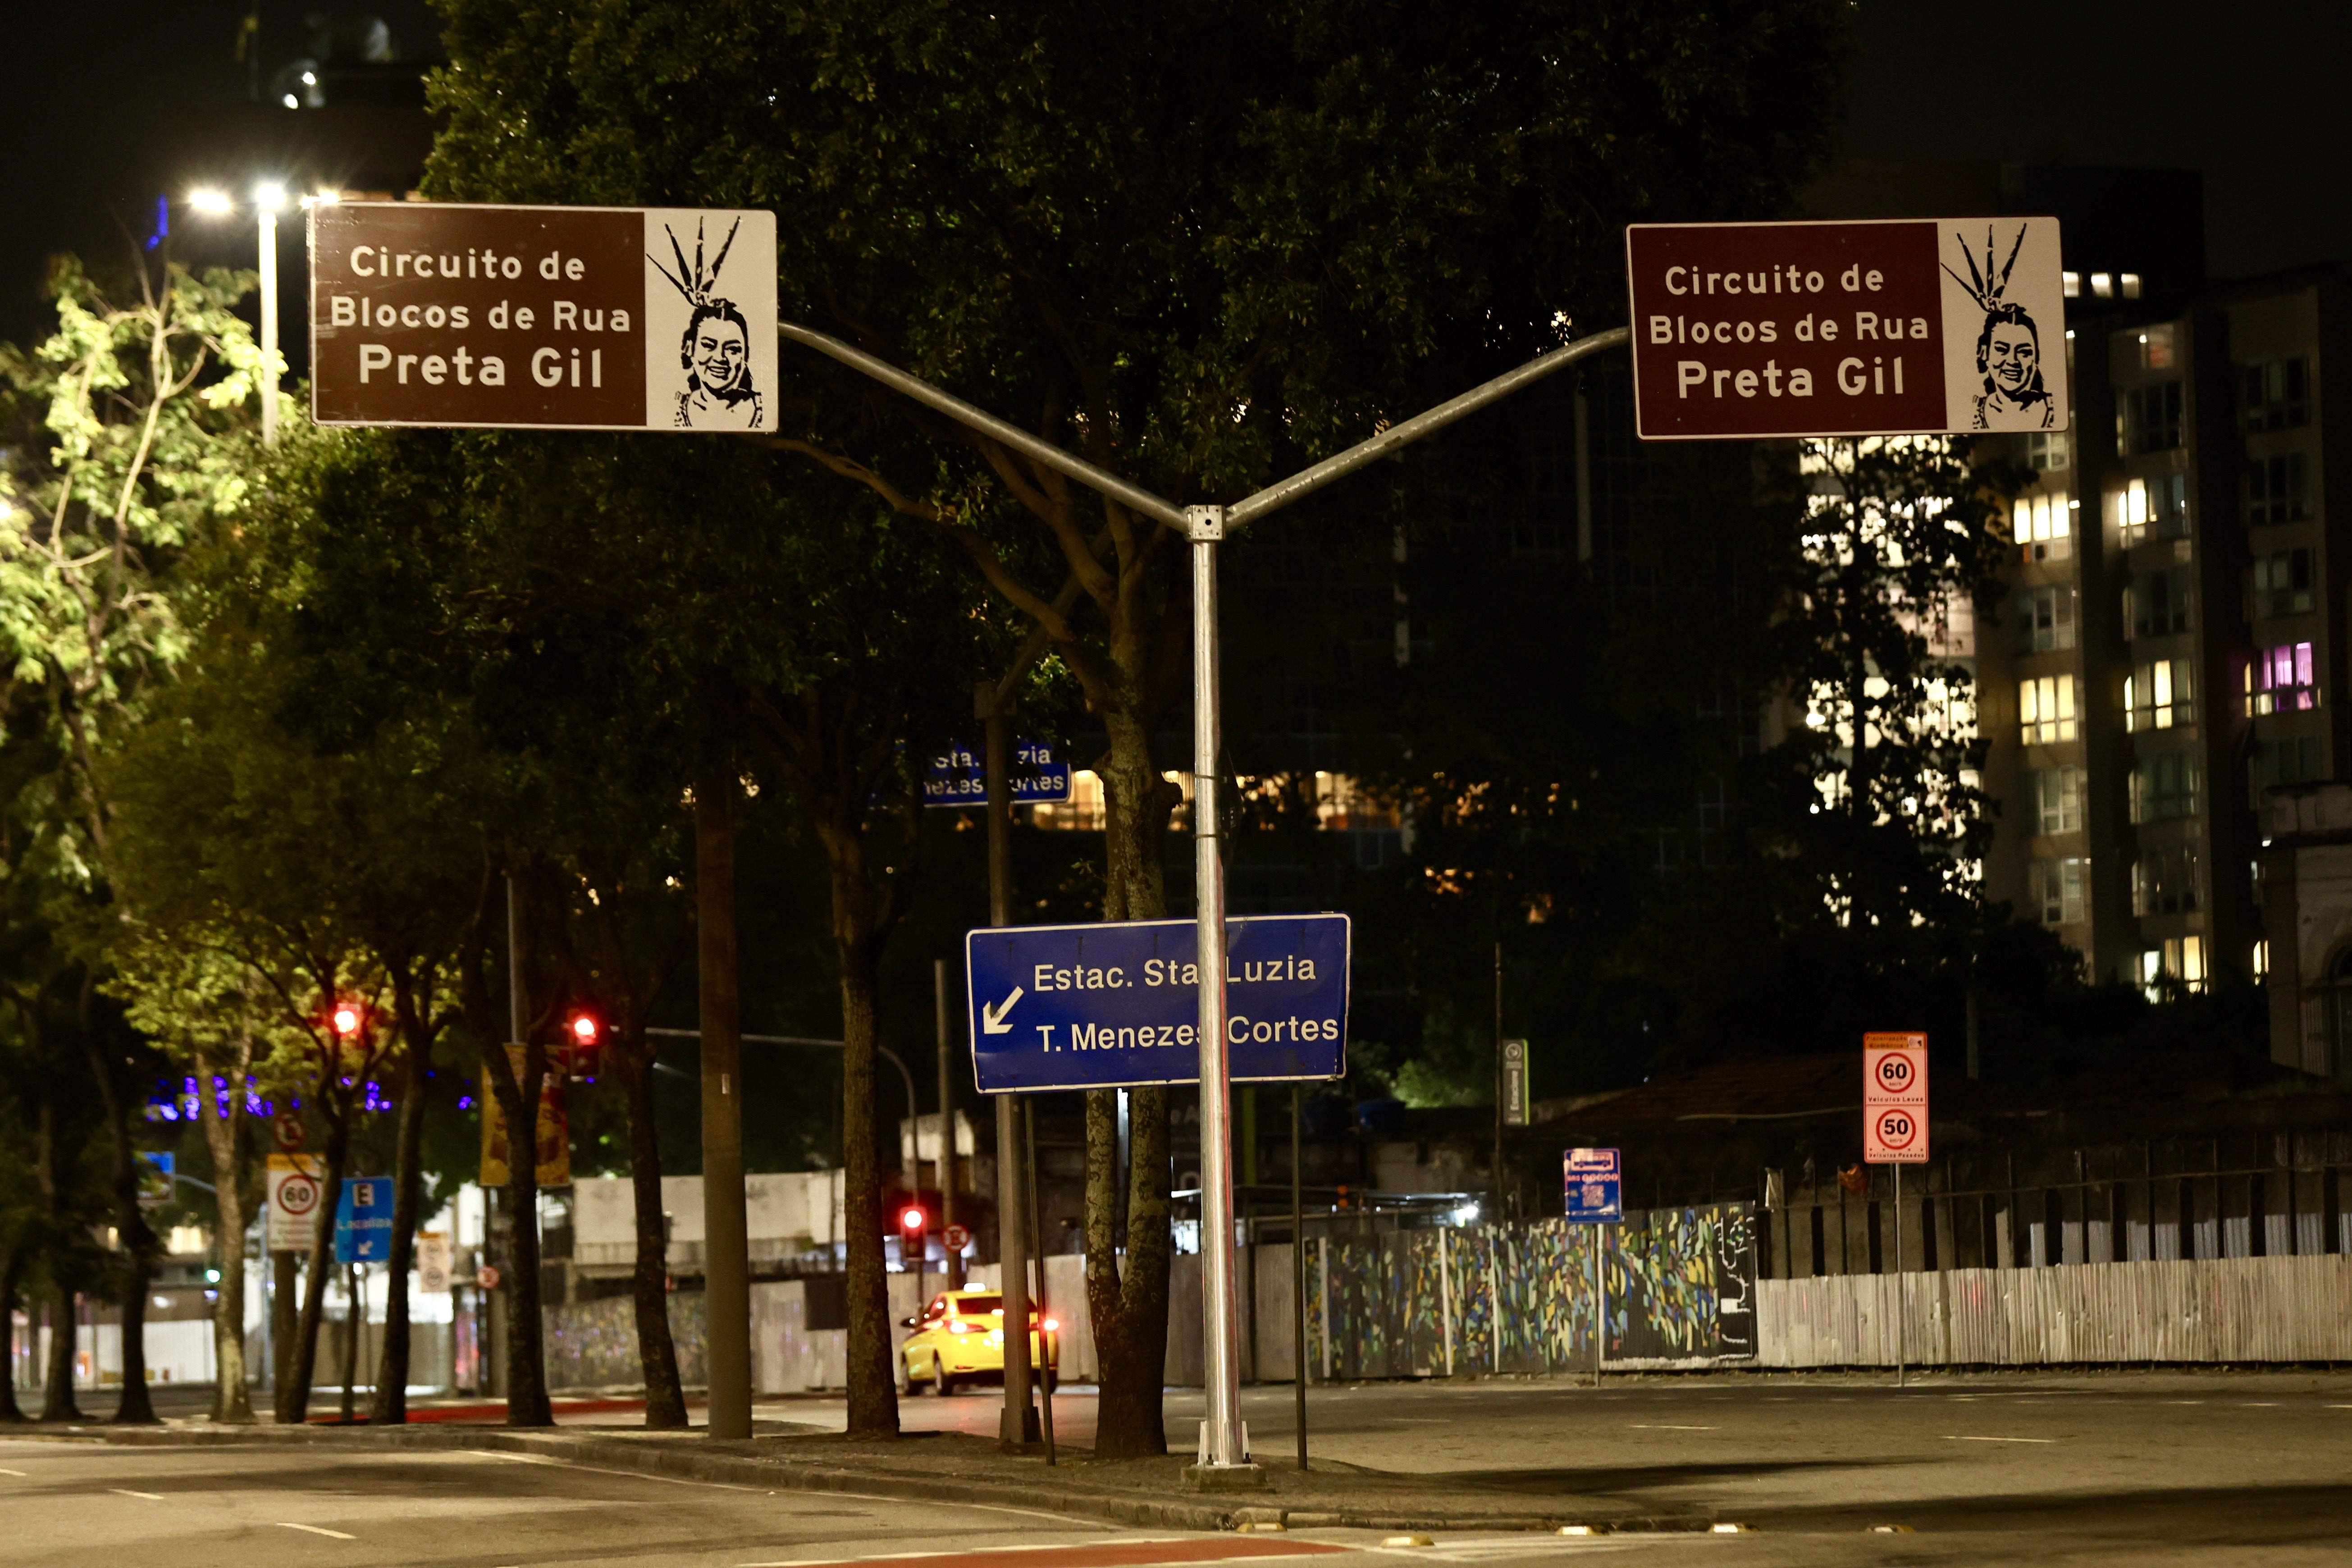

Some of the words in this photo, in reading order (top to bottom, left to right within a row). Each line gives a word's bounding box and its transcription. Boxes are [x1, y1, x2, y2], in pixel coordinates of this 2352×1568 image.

[350, 246, 521, 279] Circuito
[539, 251, 585, 280] de
[1666, 265, 1824, 295] Circuito
[1841, 263, 1884, 292] de
[331, 296, 469, 328] Blocos
[489, 301, 534, 329] de
[554, 301, 630, 331] Rua
[1650, 315, 1777, 344] Blocos
[1795, 313, 1838, 341] de
[1856, 312, 1928, 340] Rua
[360, 344, 505, 386] Preta
[532, 348, 601, 388] Gil
[1678, 359, 1813, 398] Preta
[1837, 357, 1903, 396] Gil
[1035, 964, 1133, 992] Estac.
[1226, 955, 1316, 983] Luzia
[1036, 1025, 1061, 1052] T.
[1071, 1023, 1200, 1051] Meneze
[1228, 1015, 1338, 1044] Cortes
[1883, 1063, 1907, 1079] 60
[1884, 1119, 1909, 1134] 50
[285, 1186, 310, 1202] 60
[357, 1185, 369, 1204] E
